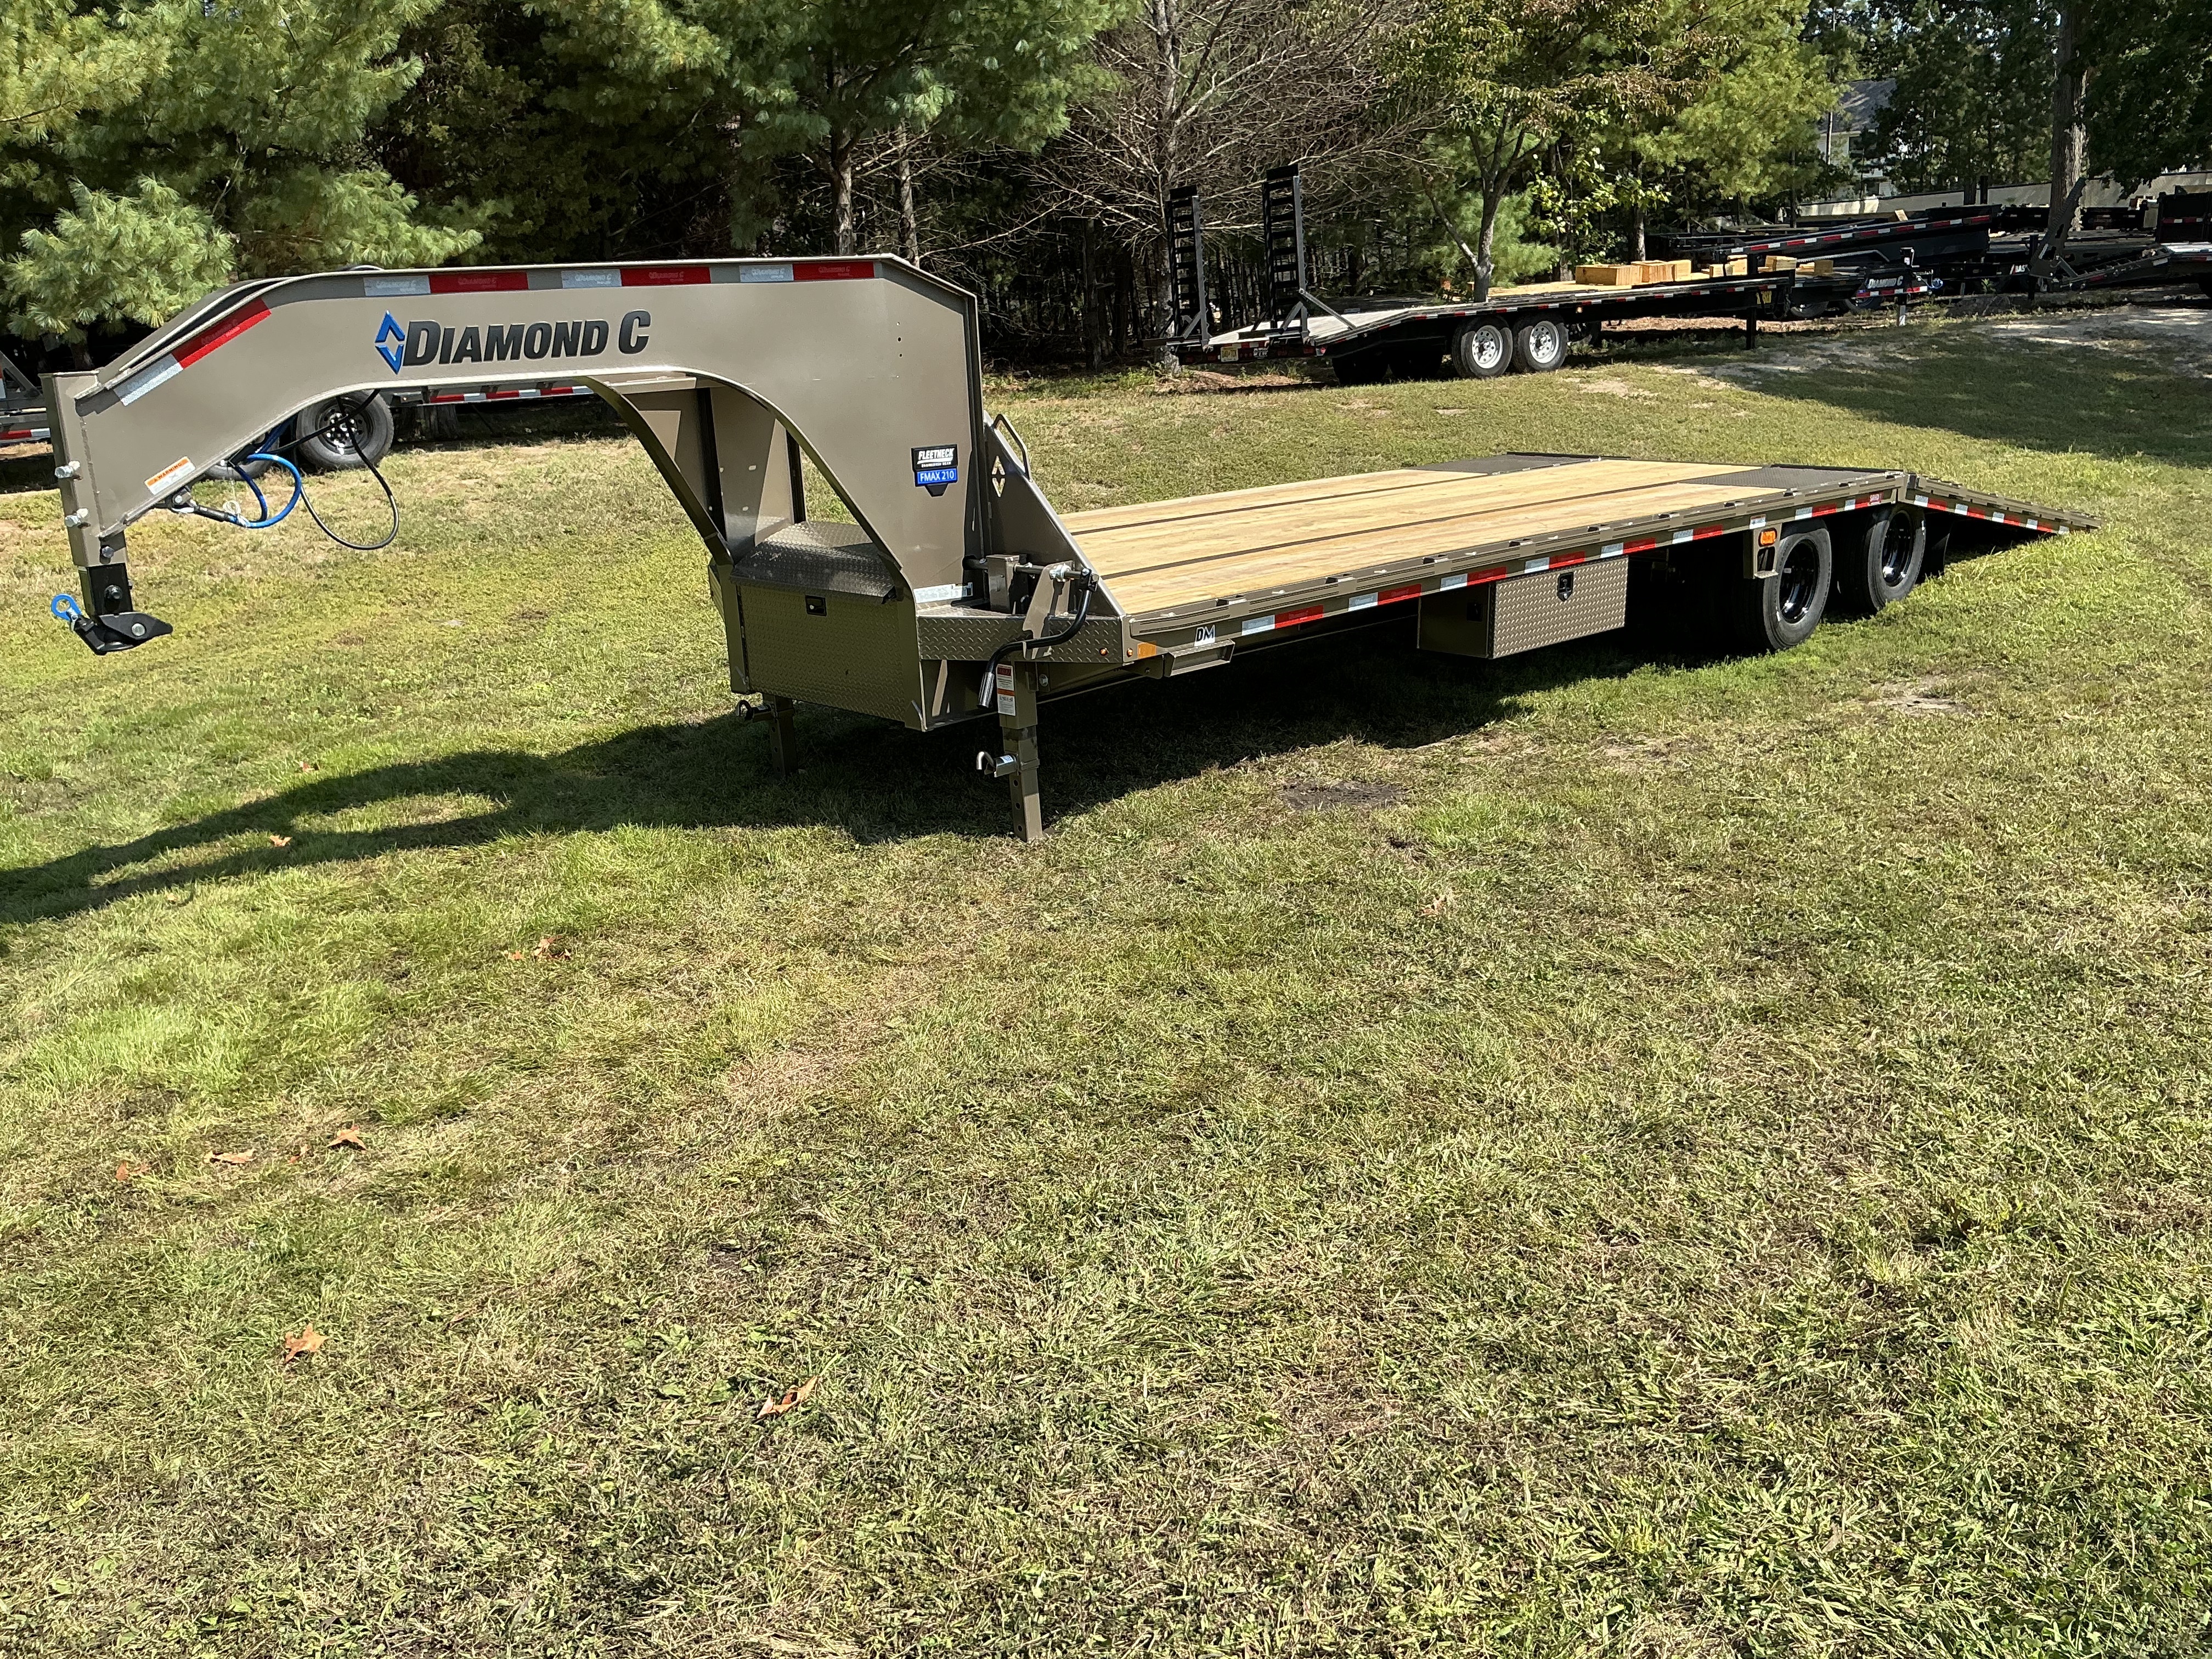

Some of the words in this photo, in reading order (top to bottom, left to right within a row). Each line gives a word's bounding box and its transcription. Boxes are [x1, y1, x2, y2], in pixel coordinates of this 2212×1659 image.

[1867, 278, 1897, 289] DIAMOND
[1897, 275, 1904, 286] C
[403, 319, 609, 366] DIAMOND
[618, 310, 651, 355] C
[918, 448, 955, 460] FLEETNECK
[157, 462, 182, 479] WARNING
[920, 471, 940, 482] FMAX
[941, 470, 955, 480] 210
